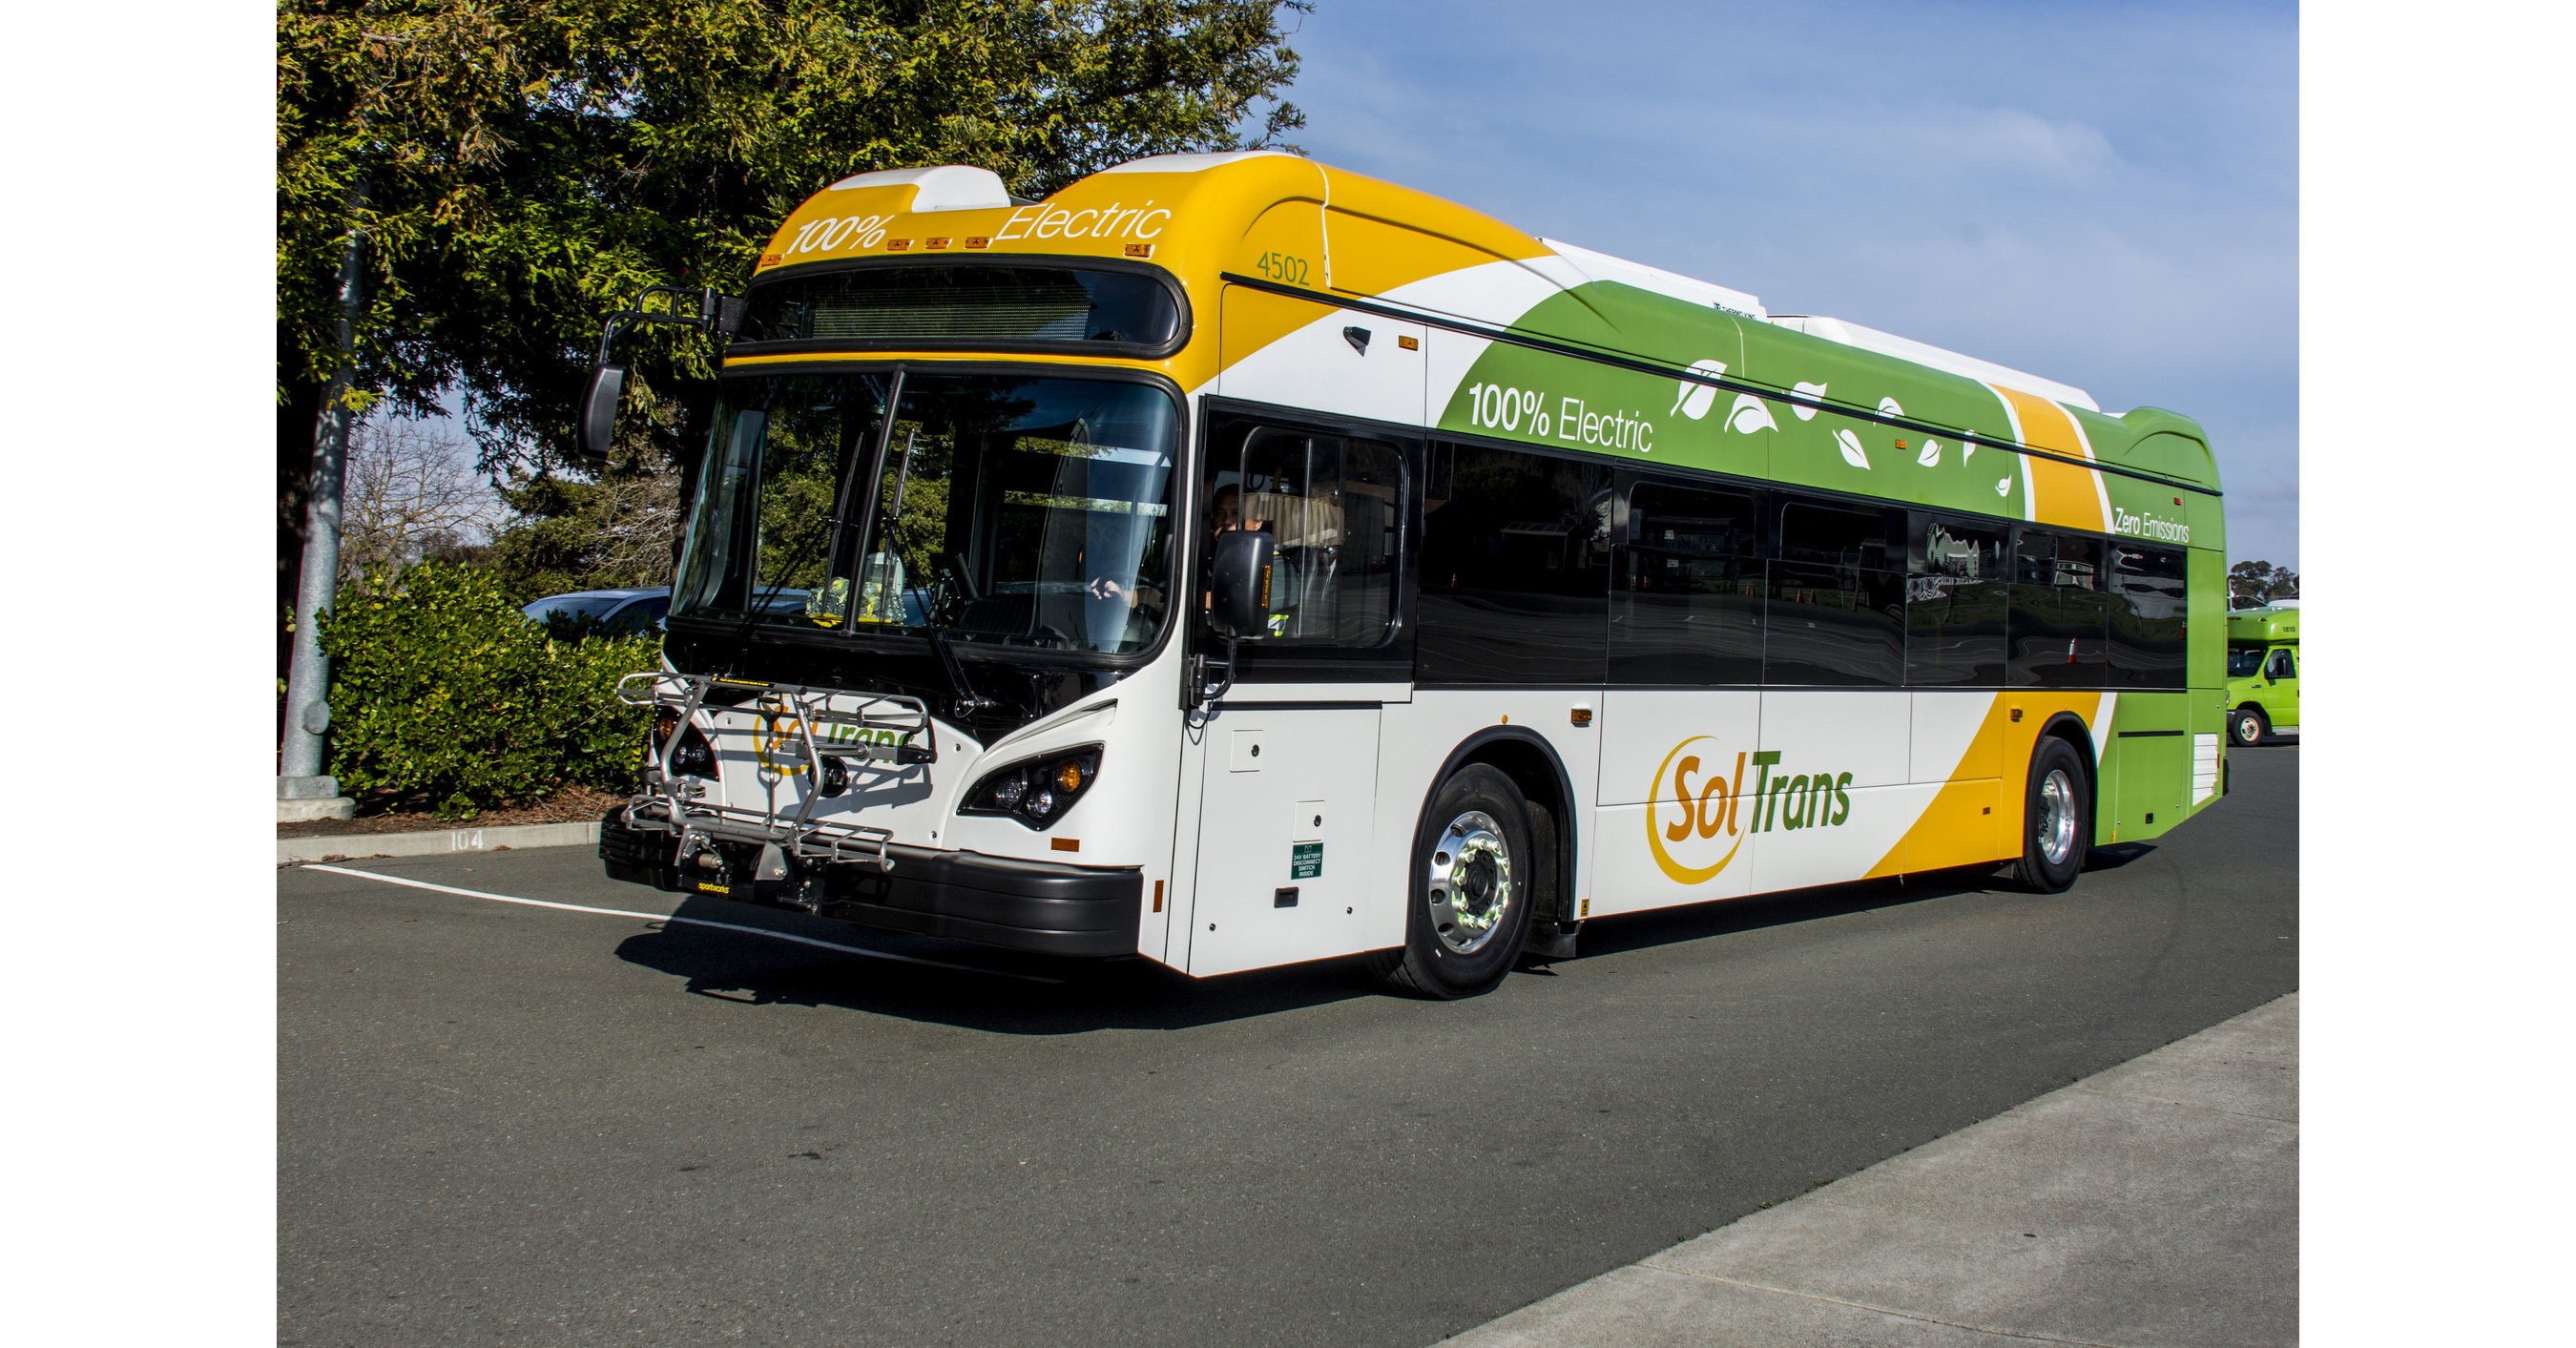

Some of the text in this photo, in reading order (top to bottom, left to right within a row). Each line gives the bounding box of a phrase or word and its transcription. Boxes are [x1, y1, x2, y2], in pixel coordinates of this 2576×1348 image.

[786, 200, 1172, 255] 100% Electric
[1257, 251, 1310, 286] 4502
[1468, 383, 1652, 453] 100% Electric
[2114, 507, 2190, 543] Zero Emissions
[451, 829, 484, 851] 104
[698, 882, 730, 894] sportworks
